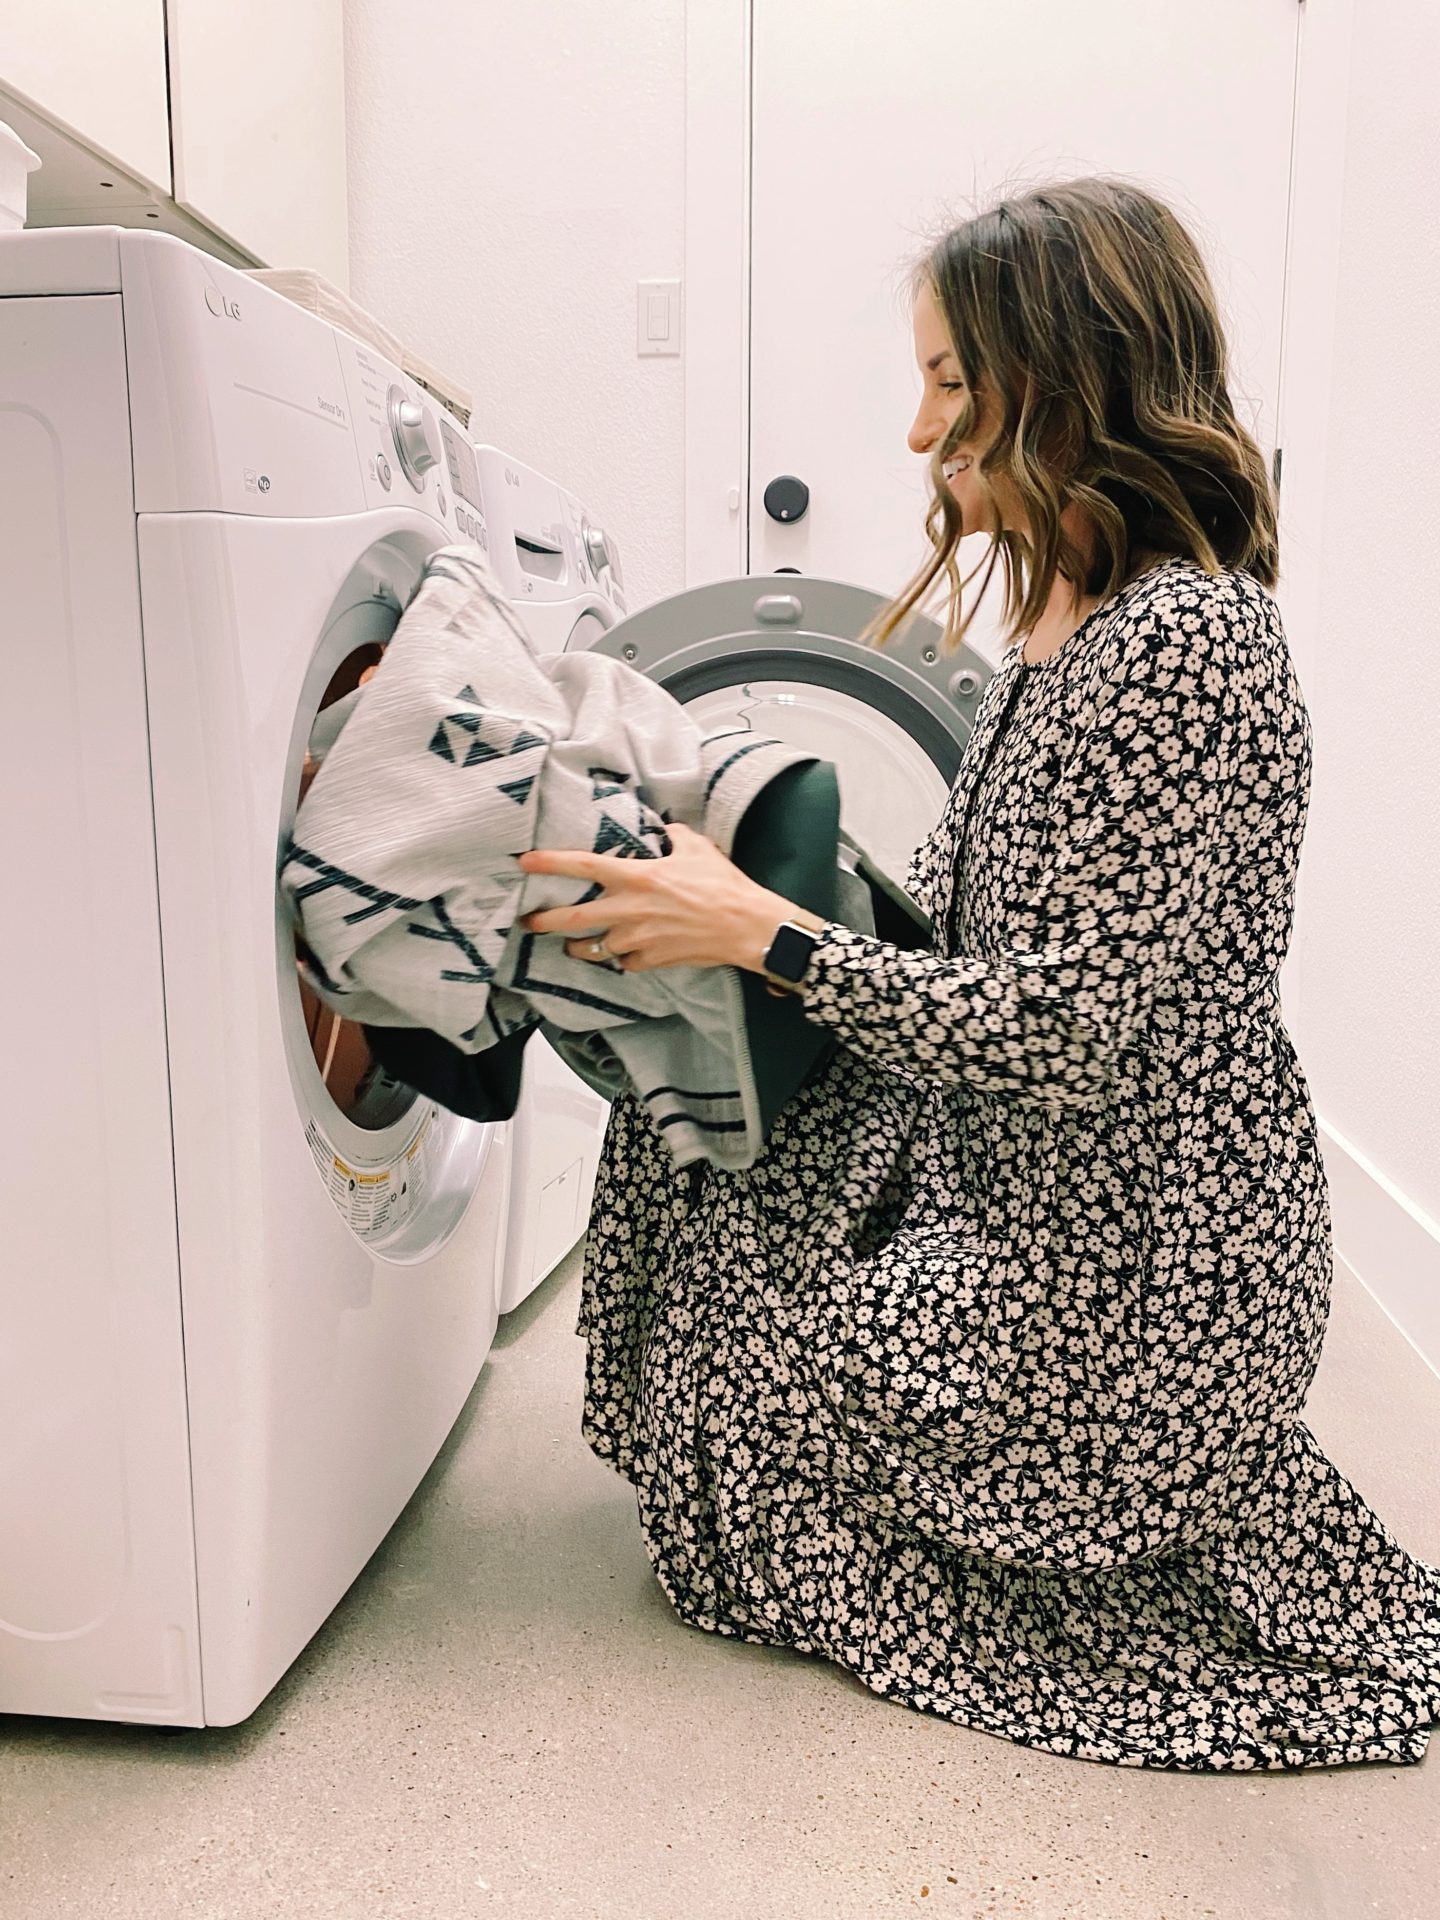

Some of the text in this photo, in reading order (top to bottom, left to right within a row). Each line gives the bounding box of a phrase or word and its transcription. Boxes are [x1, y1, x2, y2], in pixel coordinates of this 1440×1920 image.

[222, 296, 242, 322] LG
[317, 394, 346, 422] Sensor Dry
